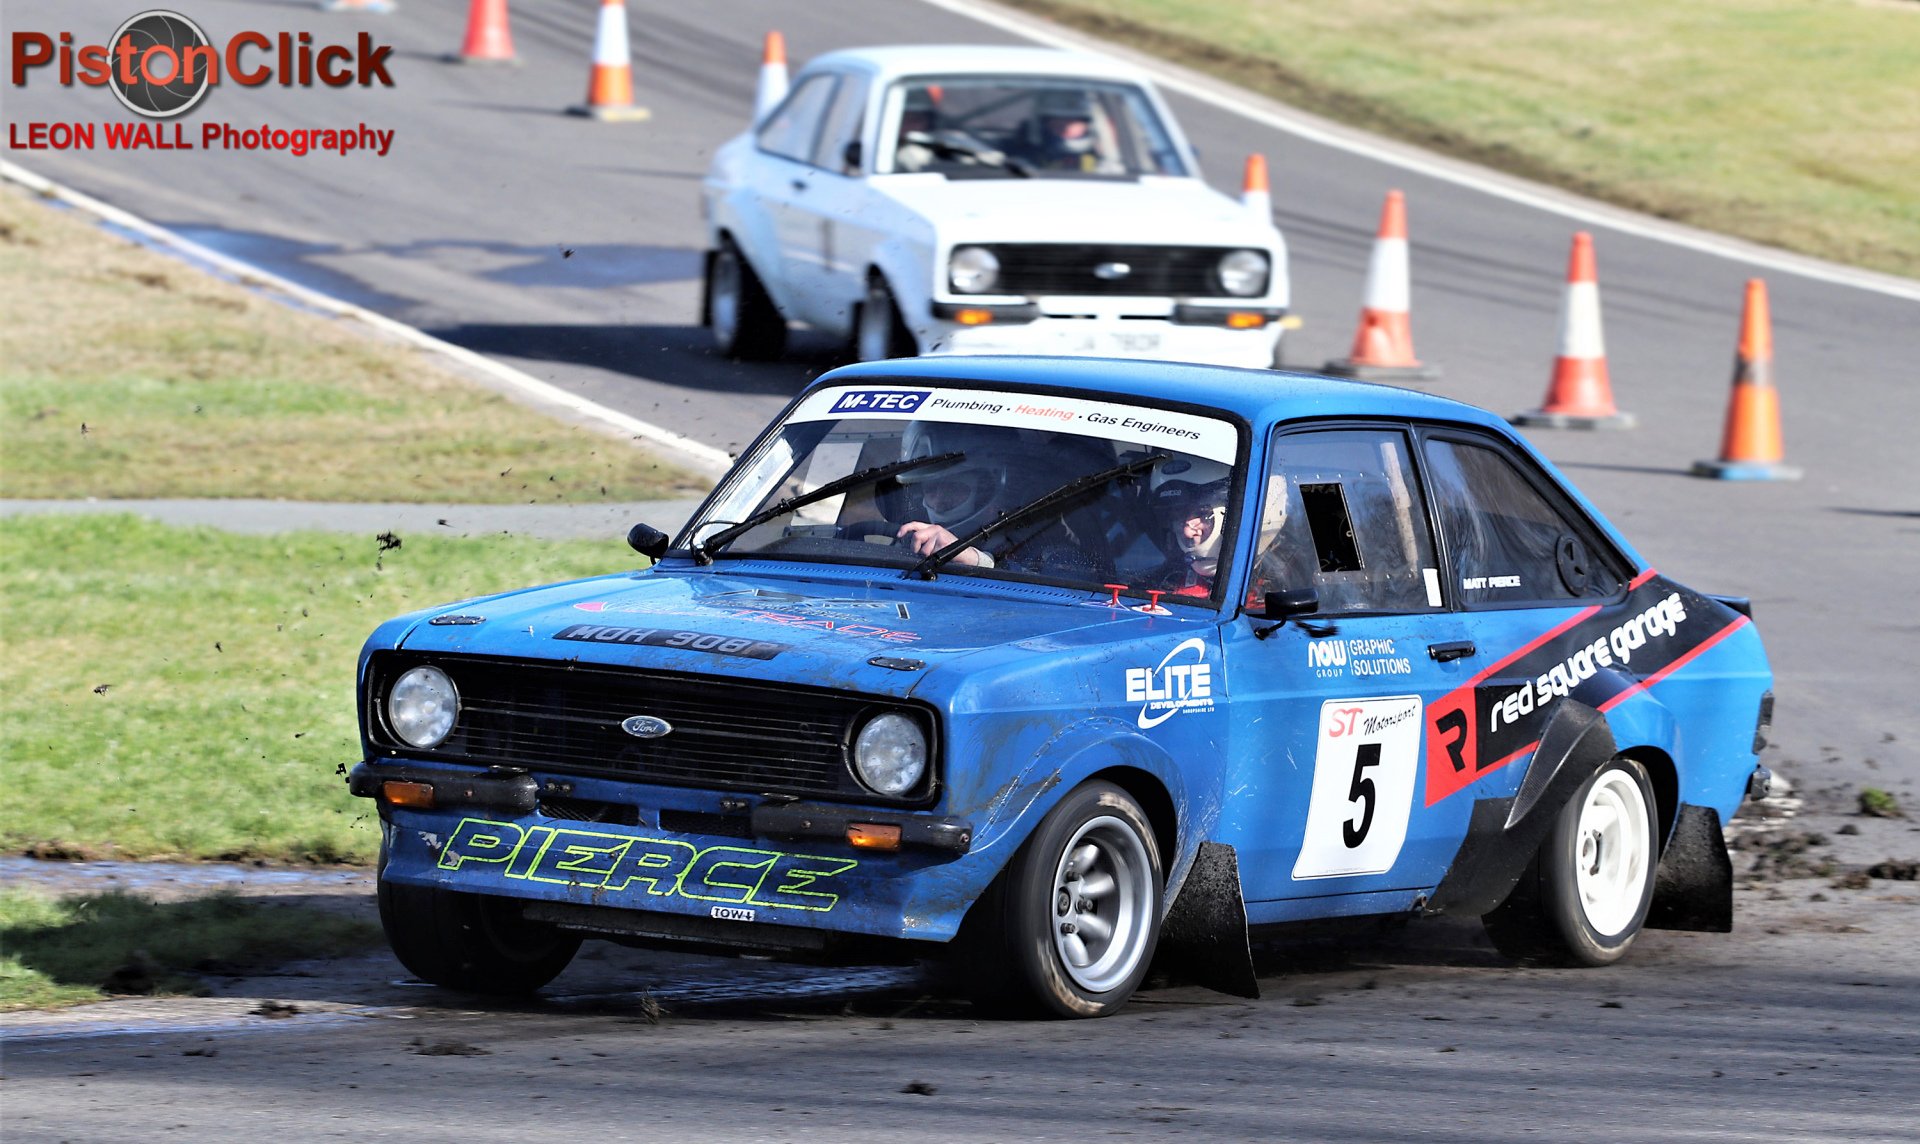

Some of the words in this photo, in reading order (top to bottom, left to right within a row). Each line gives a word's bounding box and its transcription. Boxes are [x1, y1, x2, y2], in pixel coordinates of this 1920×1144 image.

[838, 394, 919, 409] M-TEC
[931, 398, 1003, 414] Plumbing
[1014, 404, 1074, 421] Heating
[1087, 412, 1118, 425] Gas
[1121, 417, 1201, 440] Engineers
[1463, 578, 1487, 589] MATT
[566, 625, 657, 643] MOH
[1350, 639, 1395, 656] GRAPHIC
[1353, 657, 1411, 676] SOLUTIONS
[1490, 680, 1535, 732] red
[1536, 637, 1613, 706] square
[1610, 592, 1687, 664] garage
[1126, 664, 1211, 701] ELITE
[1316, 668, 1343, 678] GROUP
[632, 720, 658, 732] Ford
[1329, 707, 1363, 738] ST
[1363, 705, 1416, 736] Motorsport
[1343, 743, 1381, 849] 5
[437, 817, 858, 912] PIERCE
[714, 907, 744, 919] TOW
